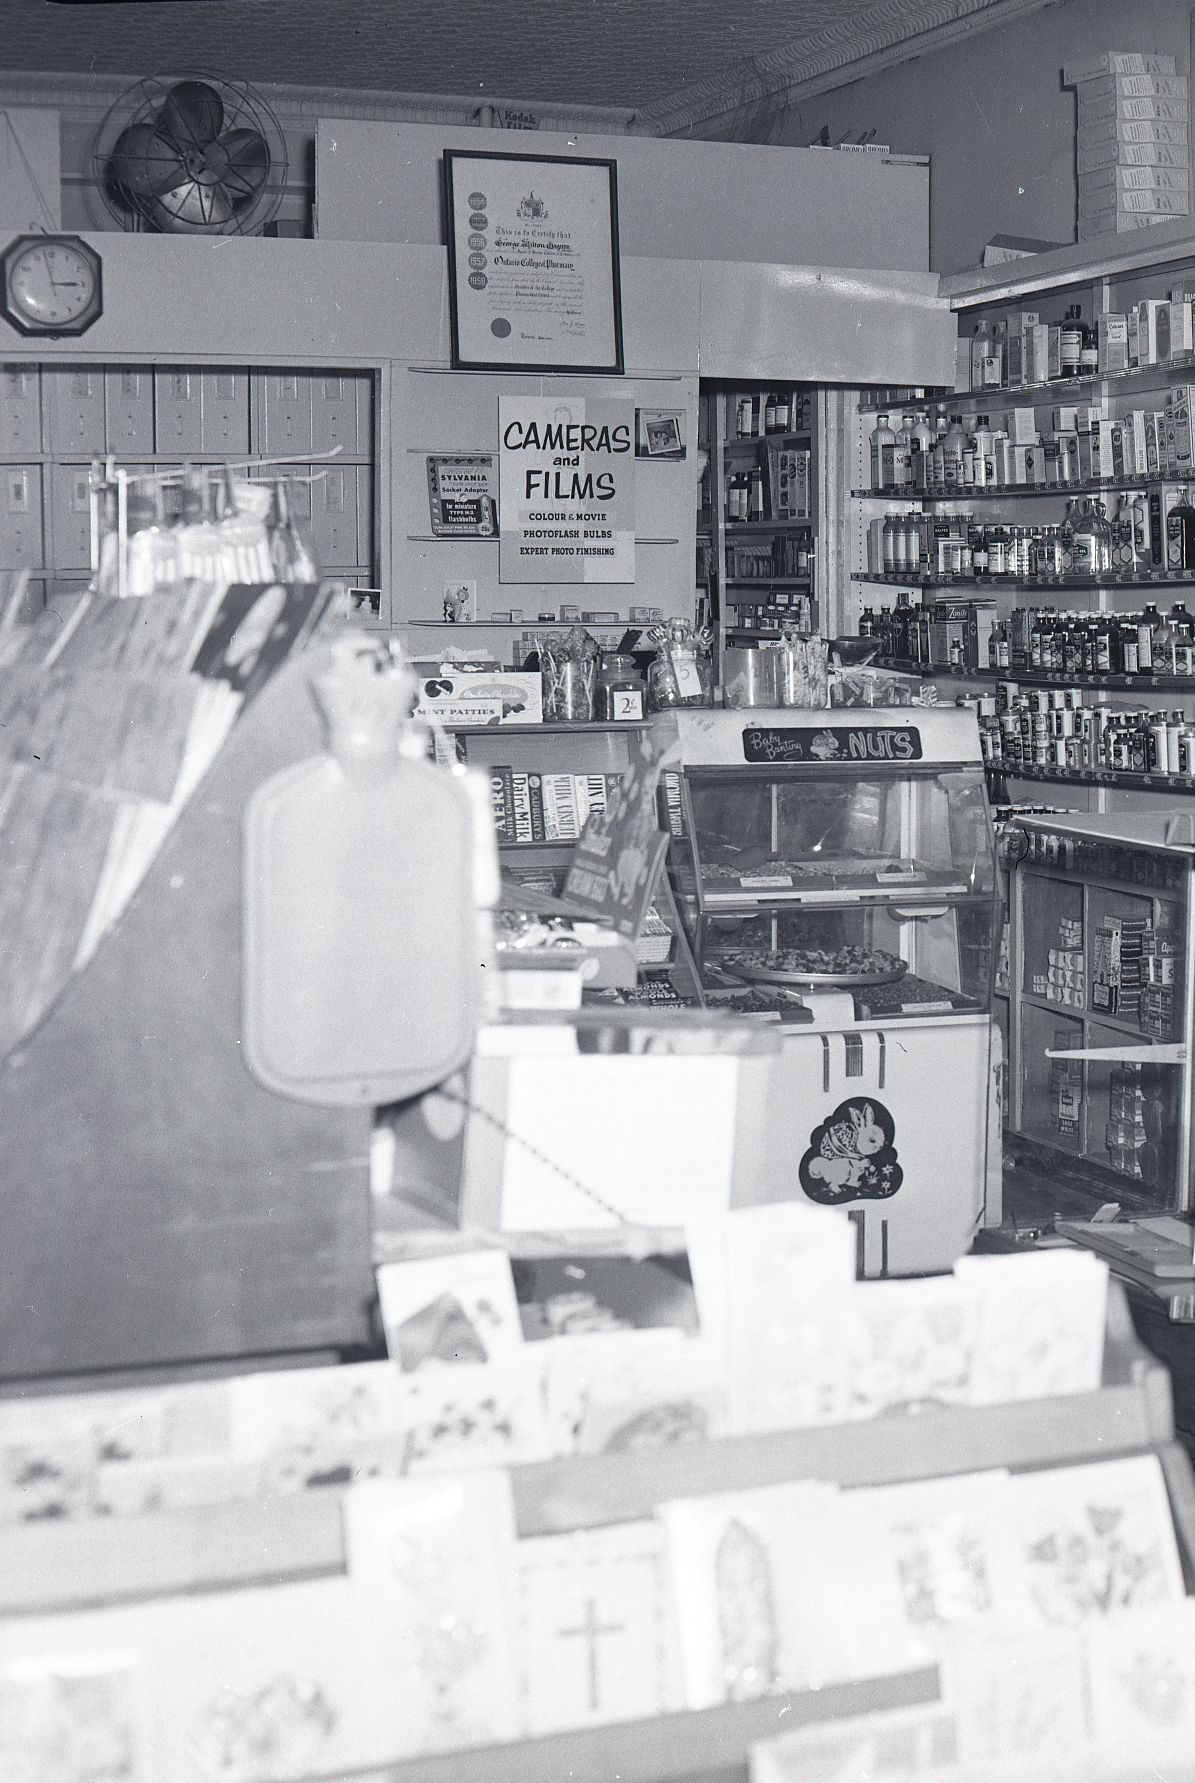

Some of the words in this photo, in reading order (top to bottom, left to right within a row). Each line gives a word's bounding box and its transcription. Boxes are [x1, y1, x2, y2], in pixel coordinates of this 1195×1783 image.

[504, 111, 536, 124] Kodak
[495, 227, 512, 236] This
[504, 421, 631, 453] CAMERAS
[553, 455, 580, 466] and
[525, 470, 616, 500] FILMS
[529, 513, 566, 521] COLOUR
[576, 513, 607, 521] MOVIE
[523, 530, 580, 539] PHOTOFLASH
[583, 530, 612, 539] BULBS
[520, 547, 549, 555] EXPERT
[551, 547, 574, 555] PHOTO
[576, 547, 615, 555] FINISHING
[750, 731, 781, 750] Baby
[764, 739, 803, 760] Bunting
[848, 730, 914, 758] NUTS
[513, 778, 524, 811] Dairy
[553, 776, 572, 800] MILK
[490, 776, 506, 833] AERO
[516, 811, 530, 841] Milk
